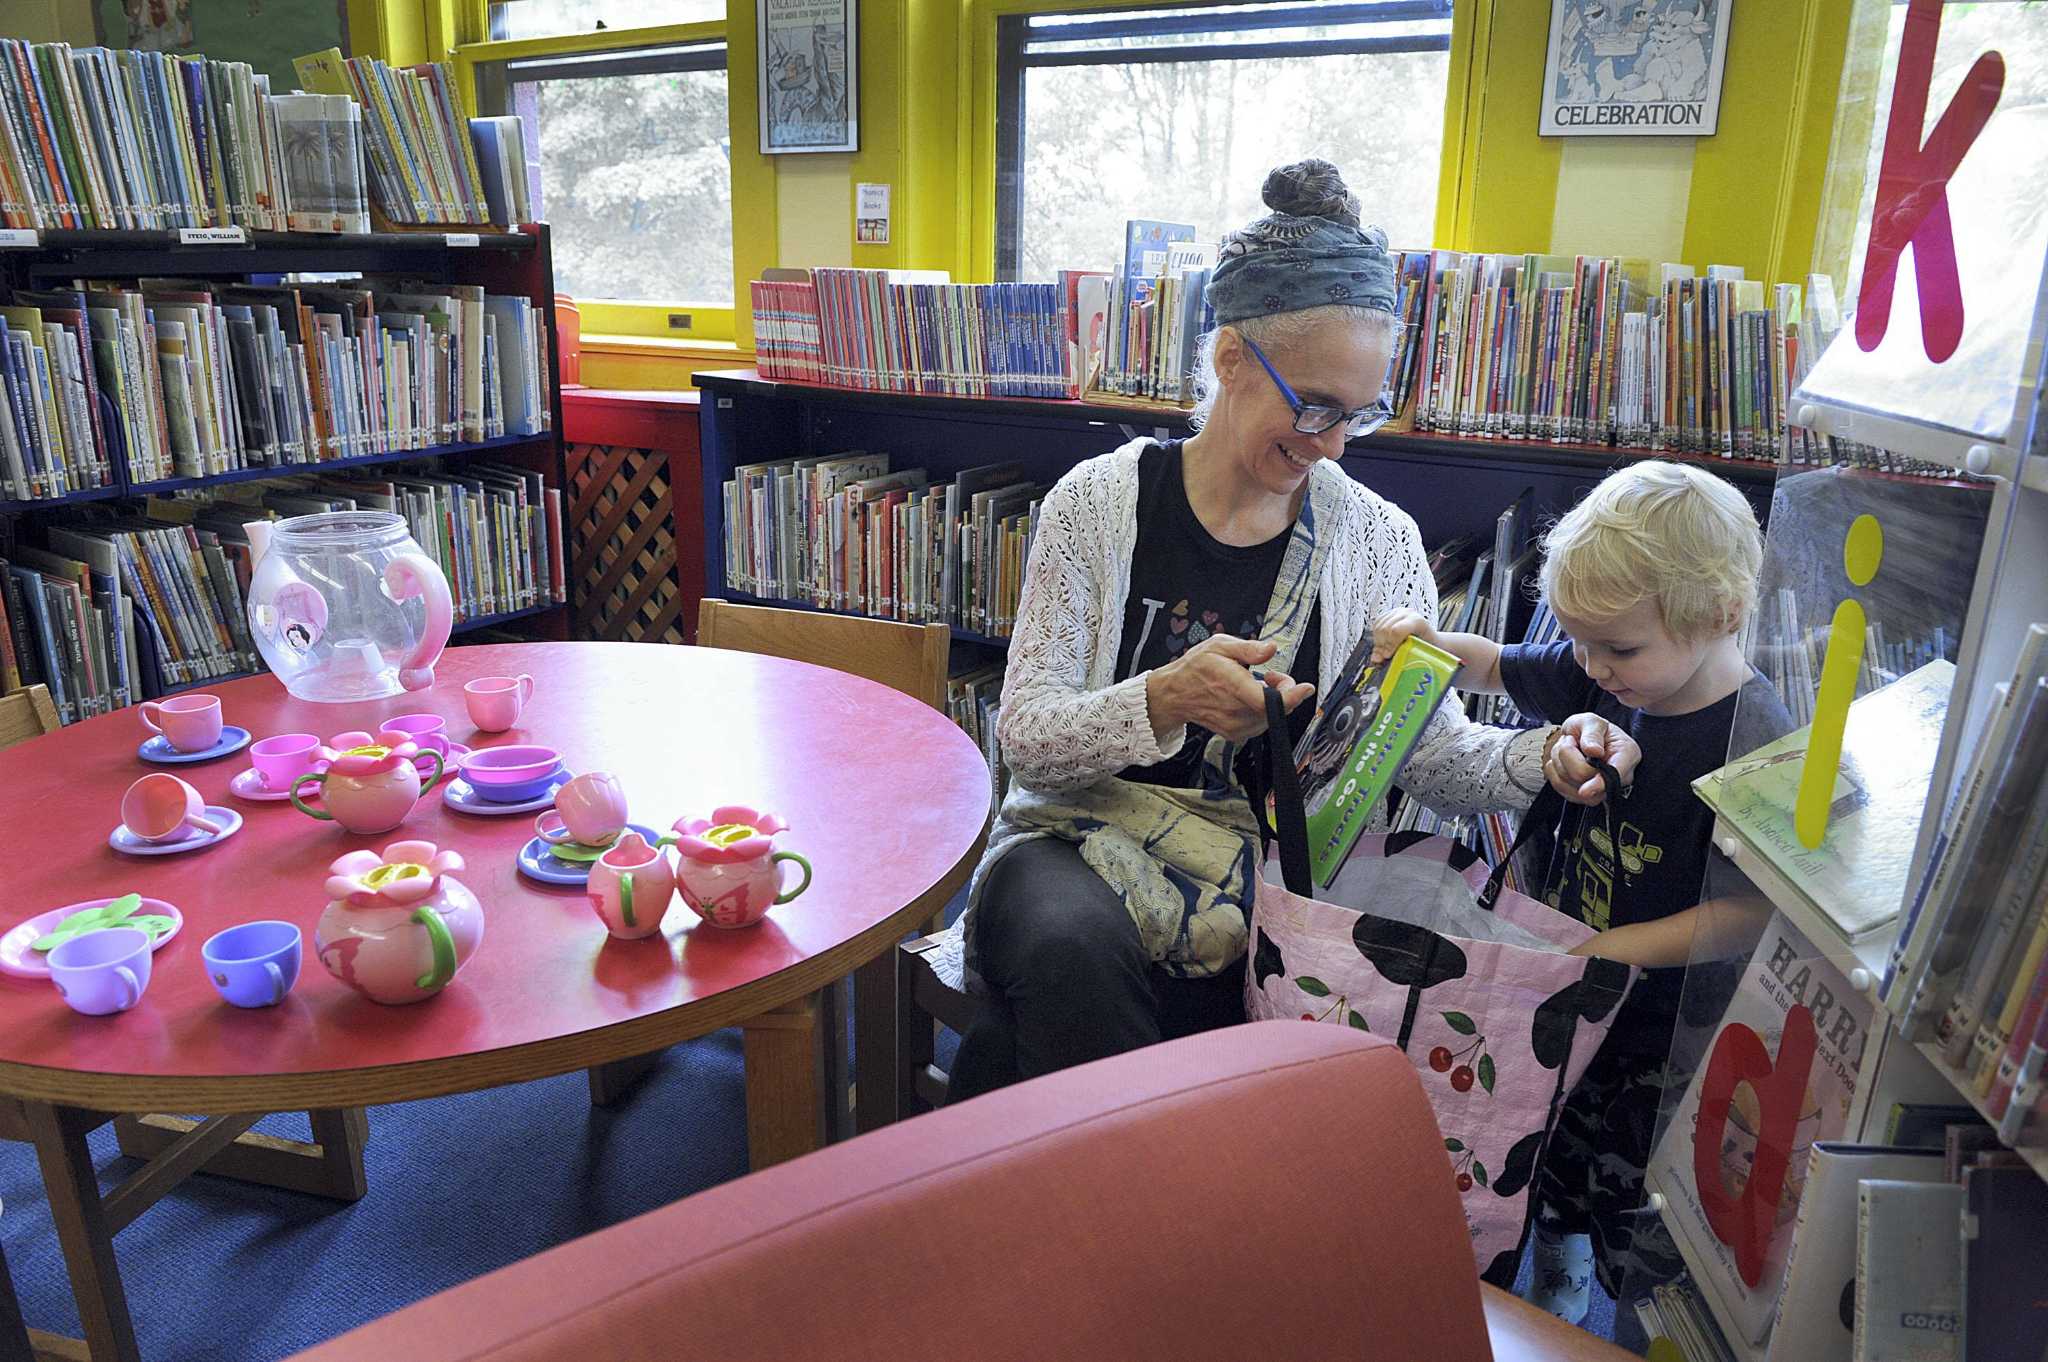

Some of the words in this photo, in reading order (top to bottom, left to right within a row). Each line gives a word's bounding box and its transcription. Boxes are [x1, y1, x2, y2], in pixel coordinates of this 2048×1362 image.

[1555, 104, 1703, 125] CELEBRATION
[1370, 672, 1433, 777] Monster
[1375, 711, 1394, 738] on
[1354, 739, 1378, 773] the
[1335, 777, 1358, 808] Go
[1319, 787, 1370, 864] Trucks
[1759, 973, 1777, 995] and
[1775, 990, 1790, 1012] the
[1818, 1039, 1836, 1067] ext
